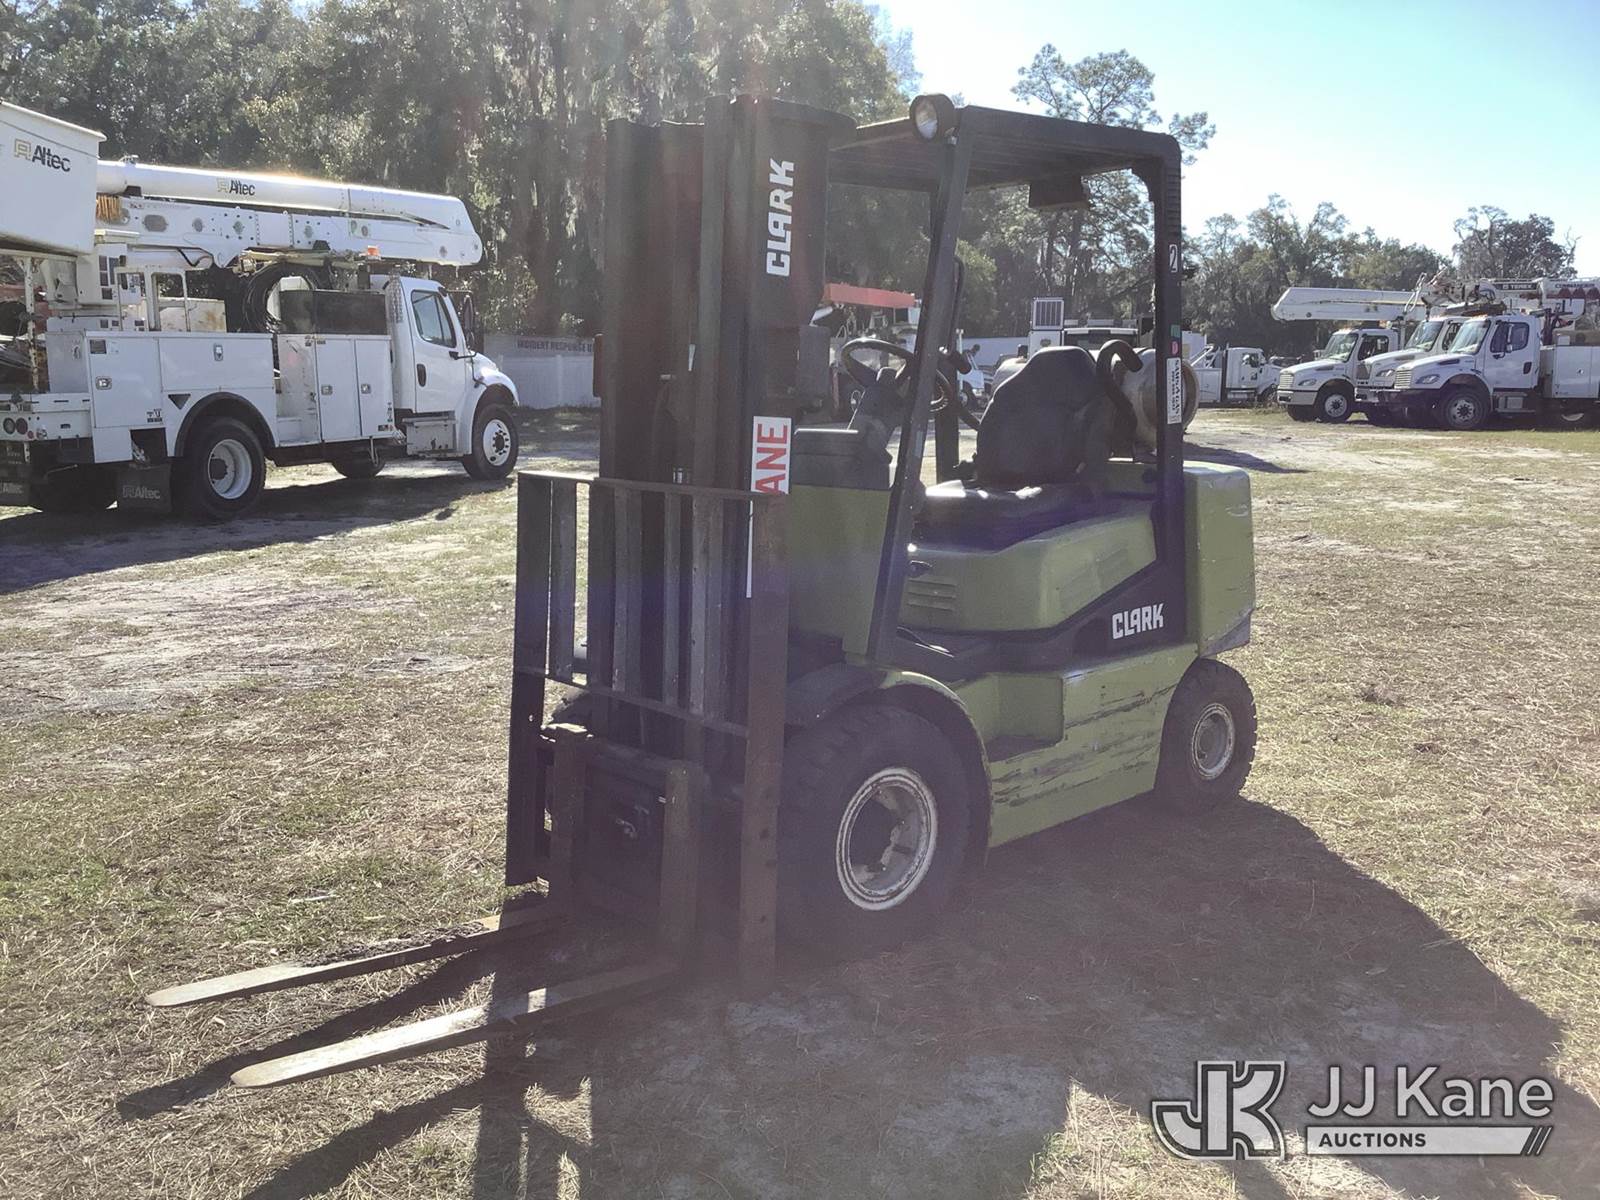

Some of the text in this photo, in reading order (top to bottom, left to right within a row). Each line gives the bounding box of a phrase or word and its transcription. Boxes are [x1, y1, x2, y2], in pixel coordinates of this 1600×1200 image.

[31, 144, 71, 172] Altec
[229, 179, 256, 196] Altec
[766, 157, 795, 277] CLARK
[754, 423, 788, 496] ANE
[134, 485, 161, 499] Altec
[1112, 603, 1164, 640] CLARK
